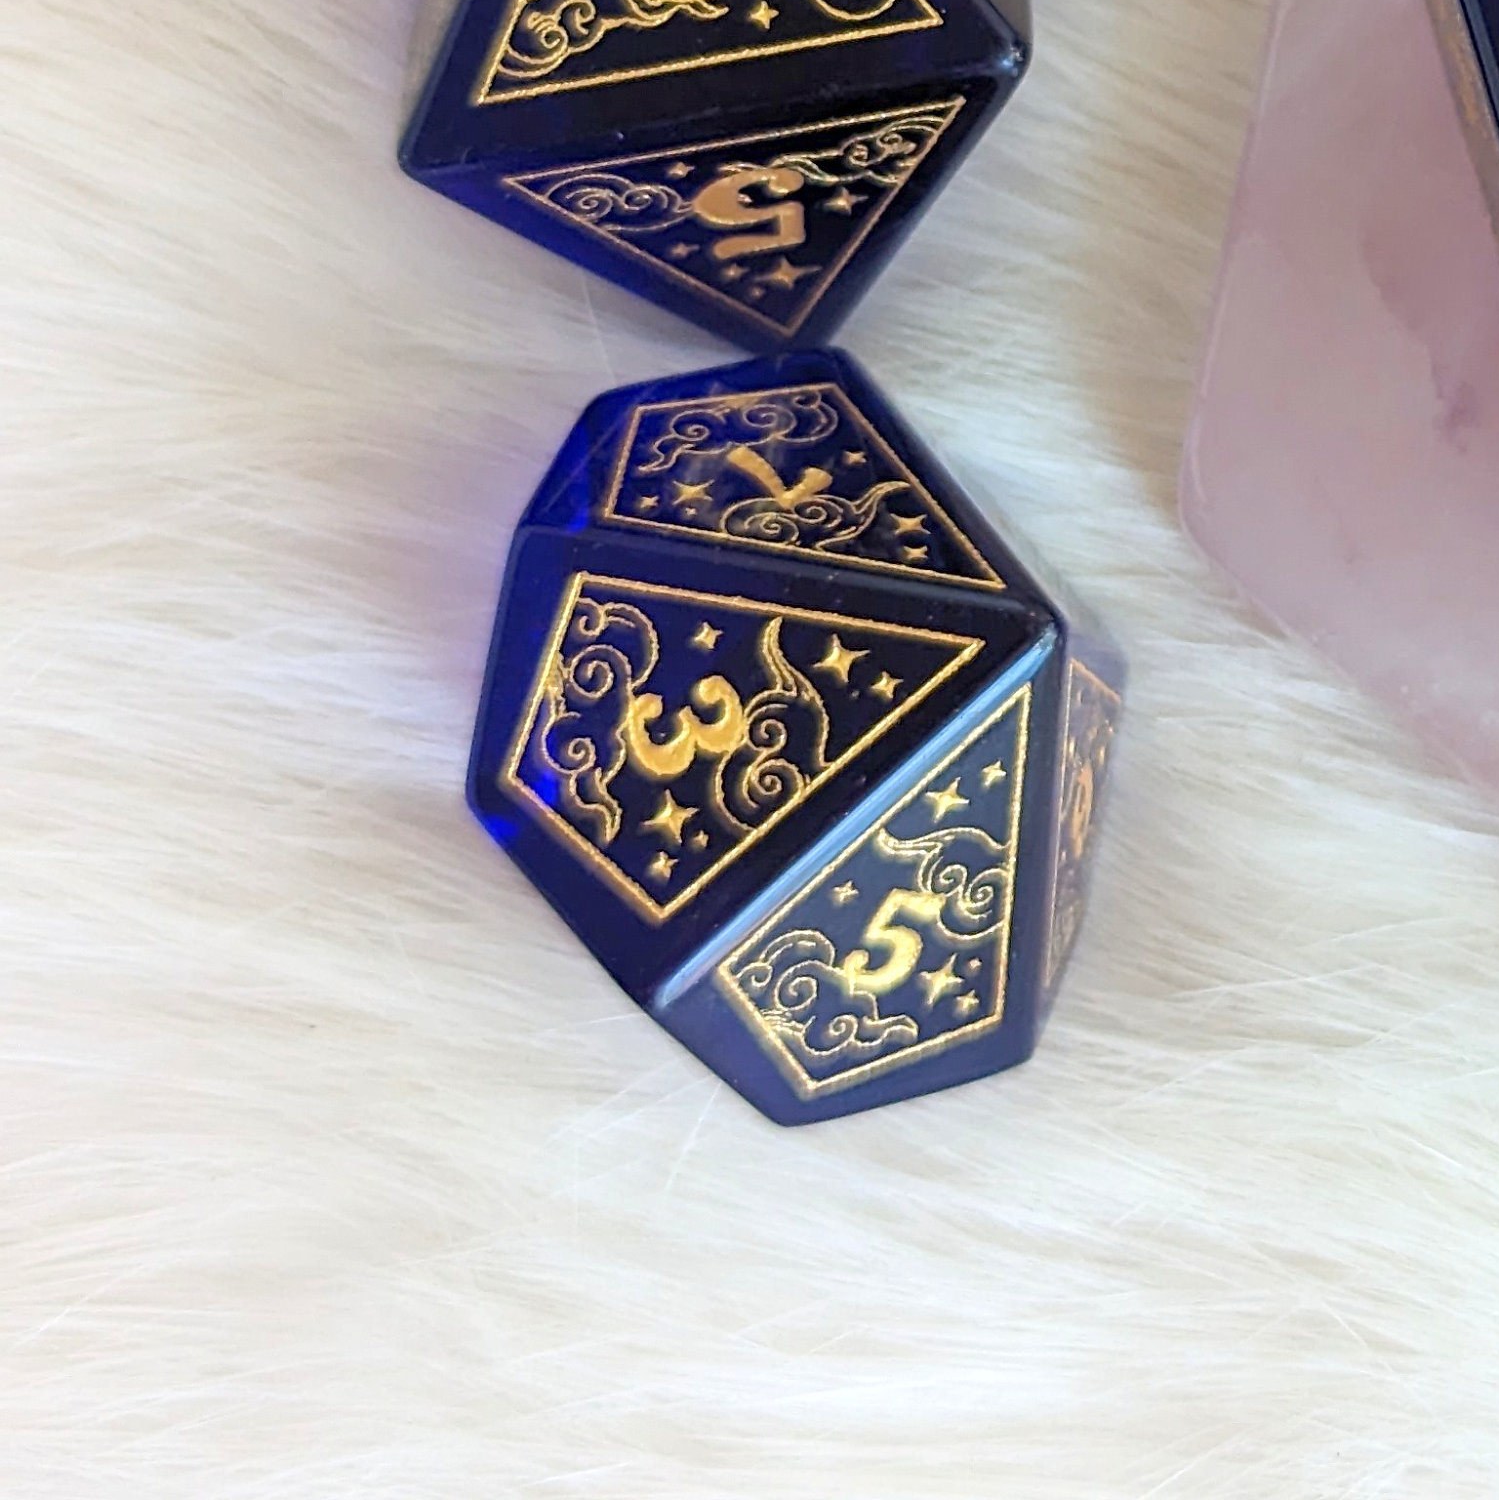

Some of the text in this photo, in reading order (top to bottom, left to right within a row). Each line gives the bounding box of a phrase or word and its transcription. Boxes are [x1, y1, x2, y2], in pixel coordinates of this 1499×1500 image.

[693, 168, 806, 259] 5
[628, 674, 746, 775] 3
[843, 889, 947, 991] 5
